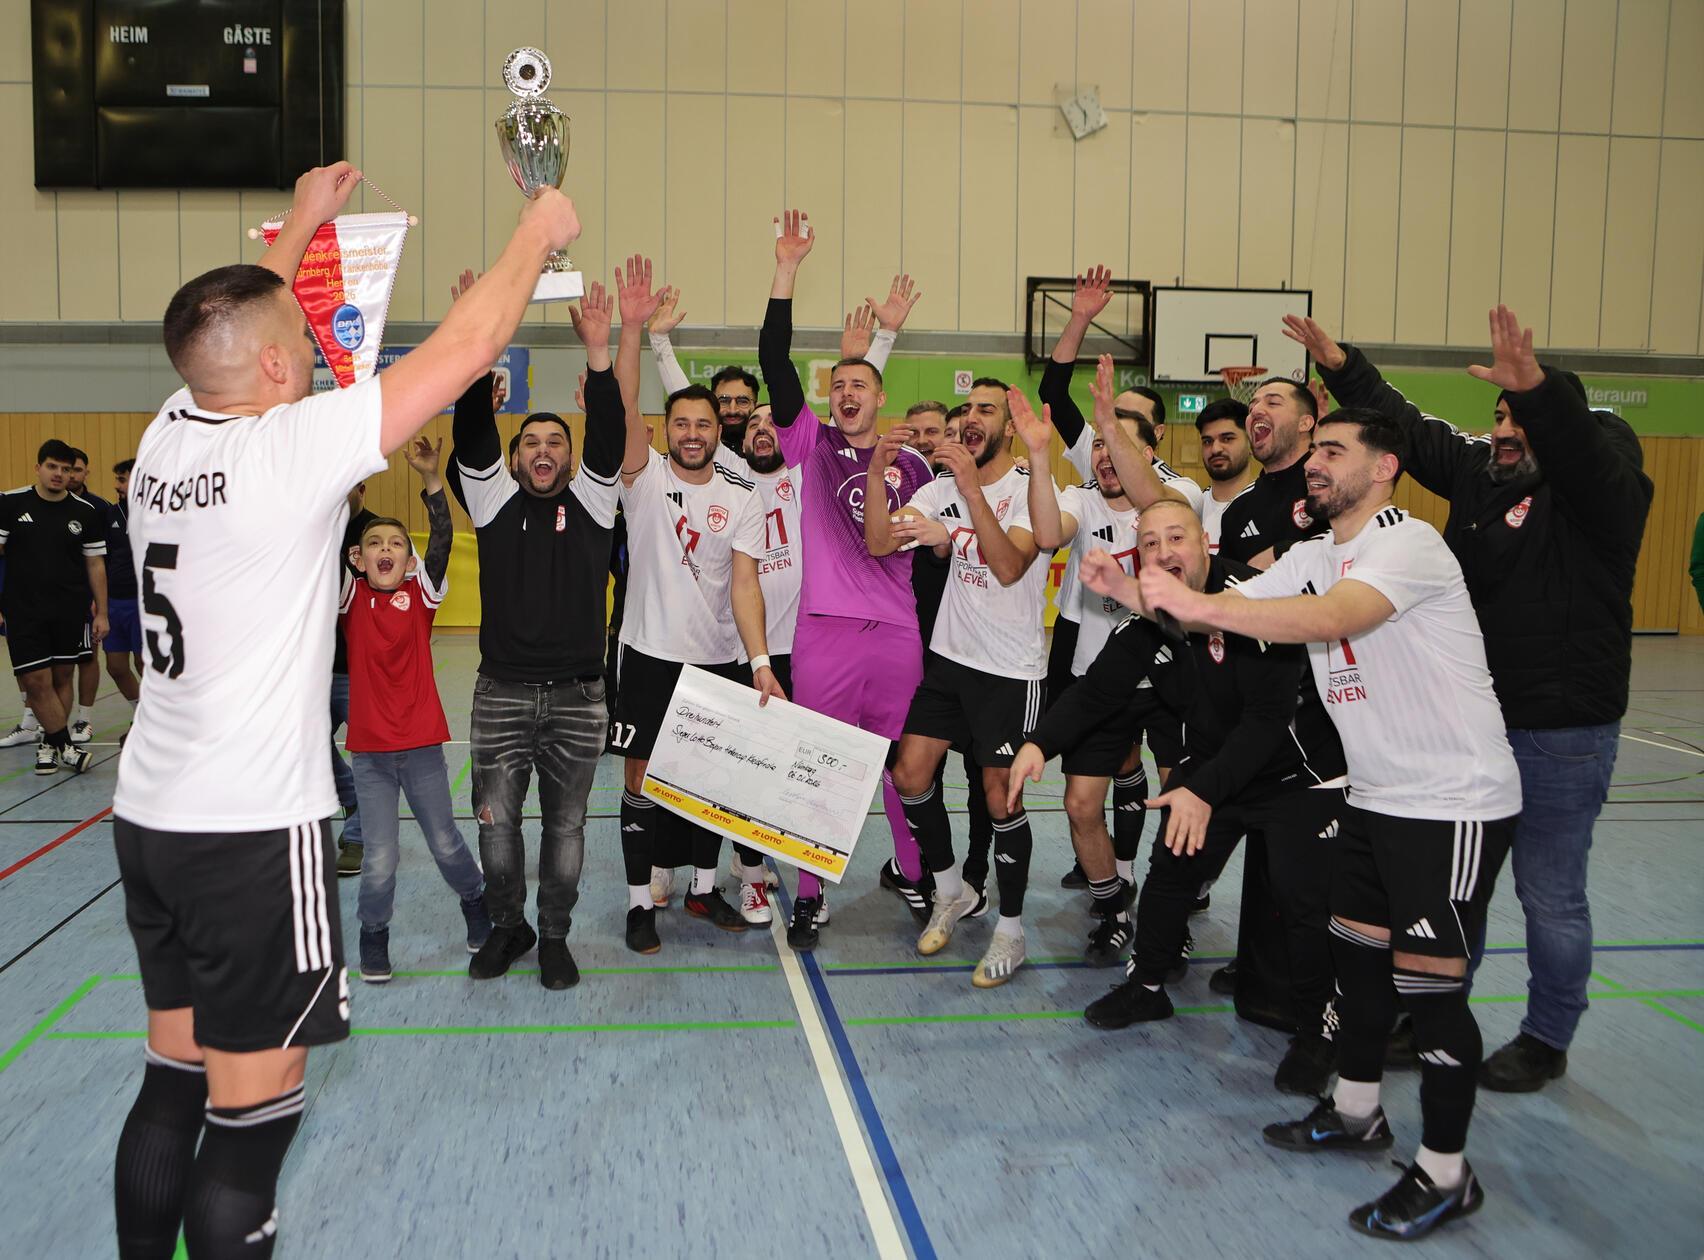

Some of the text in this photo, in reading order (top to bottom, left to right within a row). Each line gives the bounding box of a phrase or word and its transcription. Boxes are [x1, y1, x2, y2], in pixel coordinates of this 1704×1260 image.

[110, 26, 148, 43] HEIM
[223, 24, 272, 45] GÄSTE
[757, 557, 792, 575] LEVEN
[142, 542, 186, 680] 5
[611, 721, 637, 749] 17
[798, 746, 812, 755] EUR
[661, 789, 682, 803] LOTTO
[710, 812, 732, 825] LOTTO
[760, 832, 782, 845] LOTTO
[811, 852, 833, 865] LOTTO
